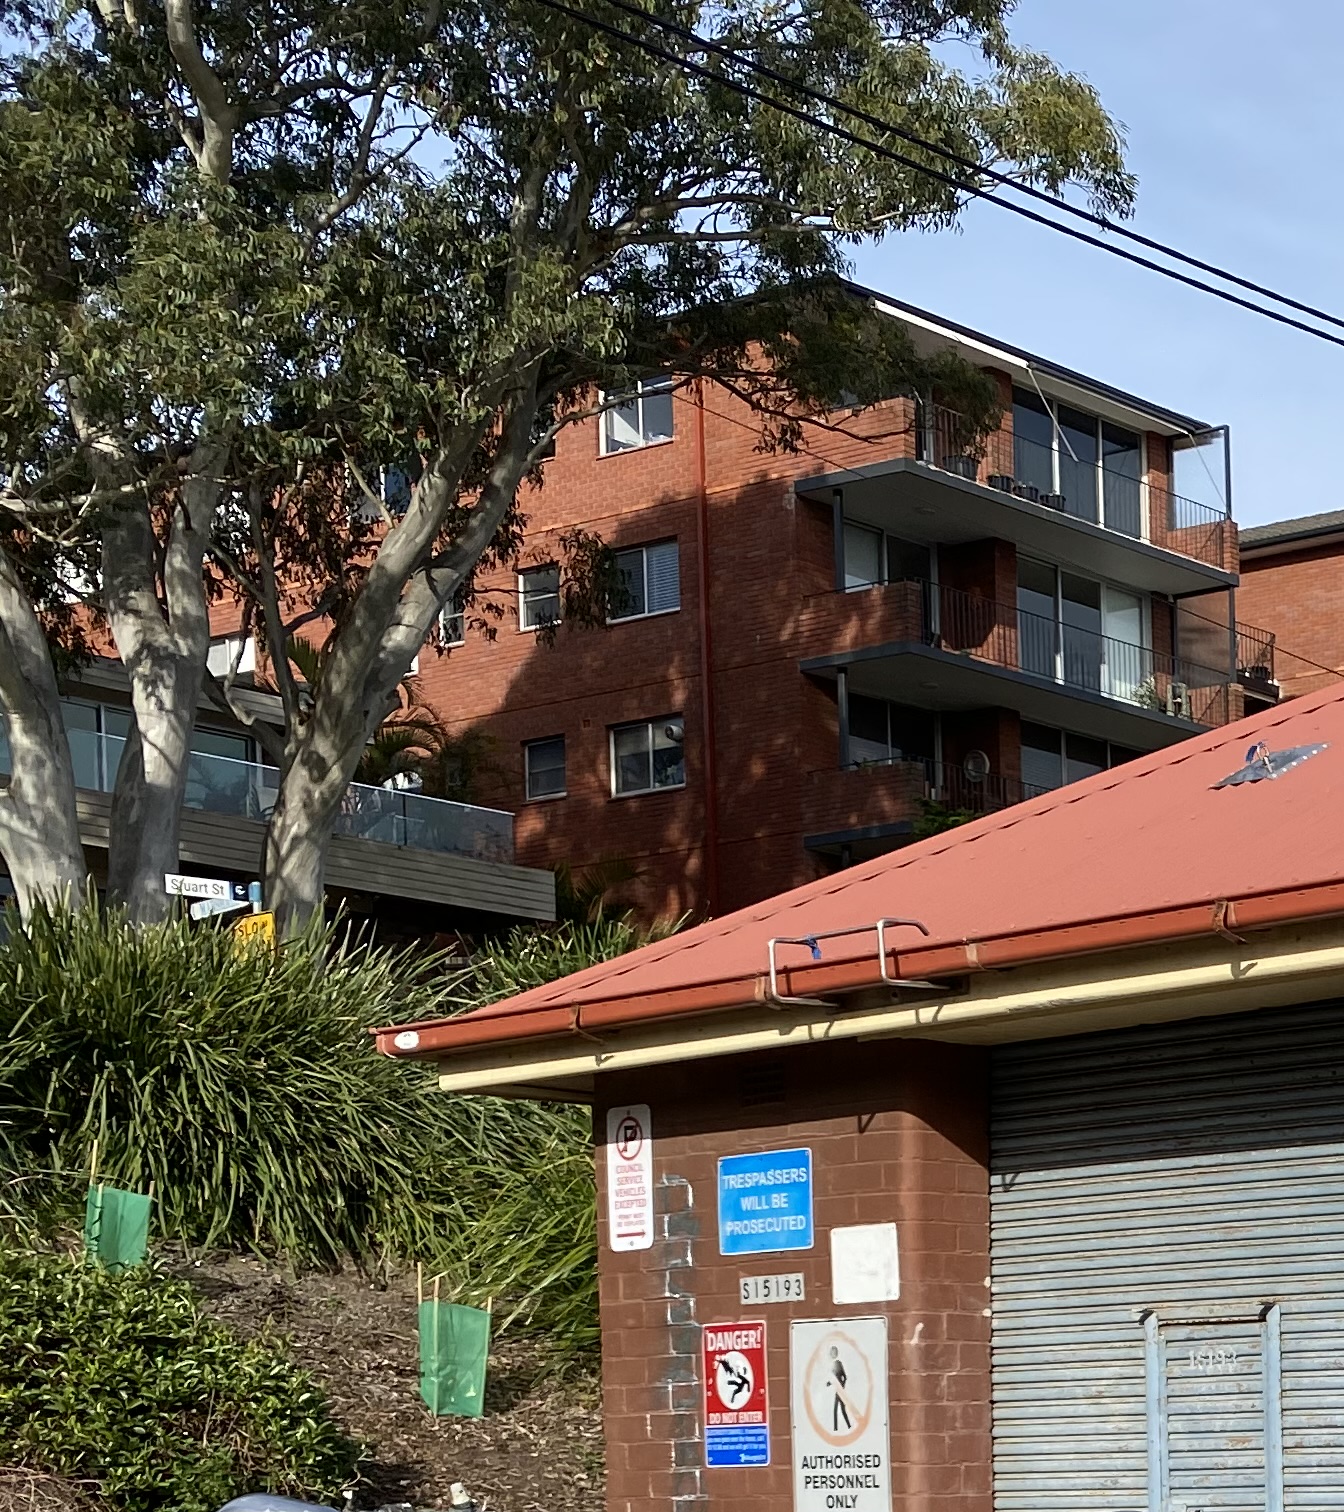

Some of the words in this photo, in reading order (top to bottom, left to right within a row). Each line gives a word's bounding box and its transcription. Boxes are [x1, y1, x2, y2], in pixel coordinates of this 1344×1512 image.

[212, 883, 225, 896] St
[722, 1168, 807, 1191] TRESPASSERS
[740, 1194, 769, 1211] WILL
[771, 1193, 789, 1209] BE
[725, 1215, 807, 1237] PROSECUTED
[707, 1329, 761, 1352] DANGER!
[709, 1412, 721, 1424] DO
[722, 1412, 738, 1424] NOT
[738, 1411, 763, 1423] ENTER
[801, 1454, 881, 1470] AUTHORISED
[804, 1474, 880, 1490] PERSONNEL
[826, 1494, 859, 1509] ONLY
